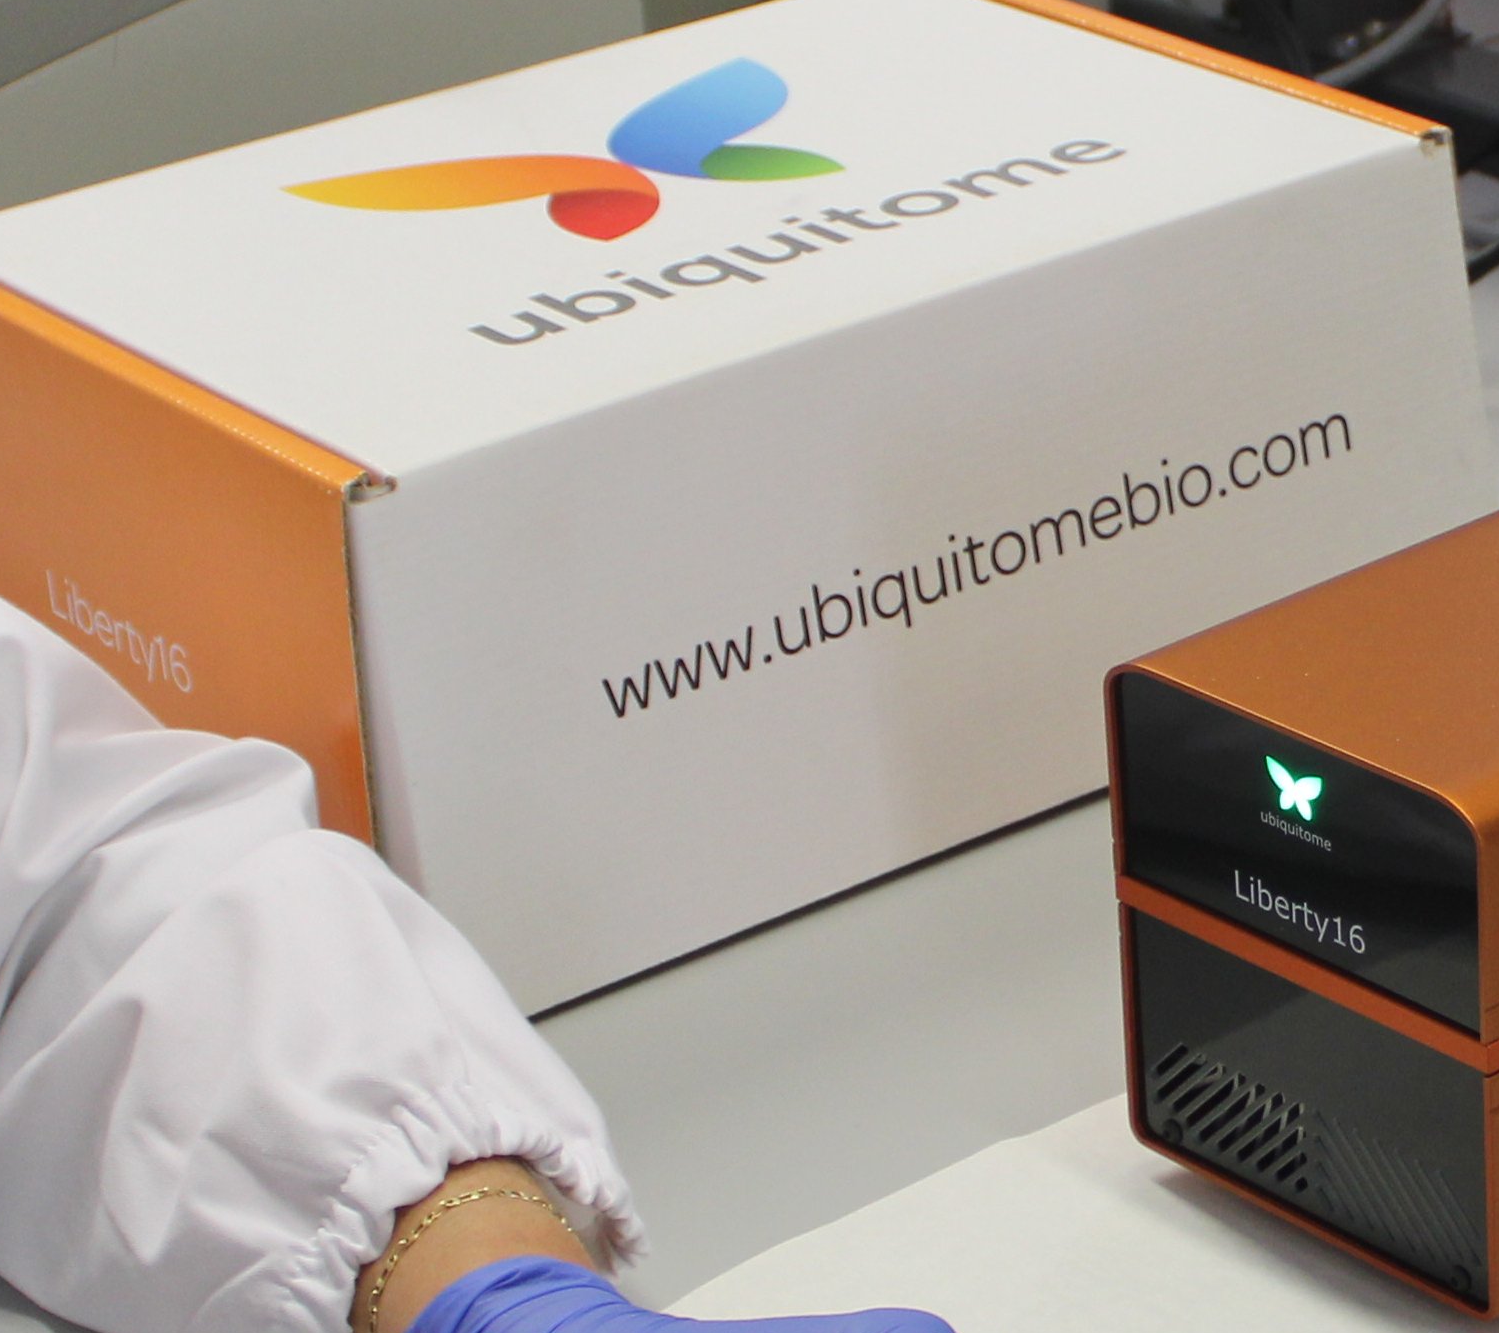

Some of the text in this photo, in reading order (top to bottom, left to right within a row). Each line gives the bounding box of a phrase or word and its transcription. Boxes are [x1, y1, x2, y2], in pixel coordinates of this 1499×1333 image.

[466, 125, 1129, 349] ubiquitome
[600, 404, 1356, 723] www.ubiquitomebio.com
[45, 568, 193, 693] Liberty16
[1260, 810, 1332, 852] ubiquitome
[1234, 869, 1367, 955] Liberty16
